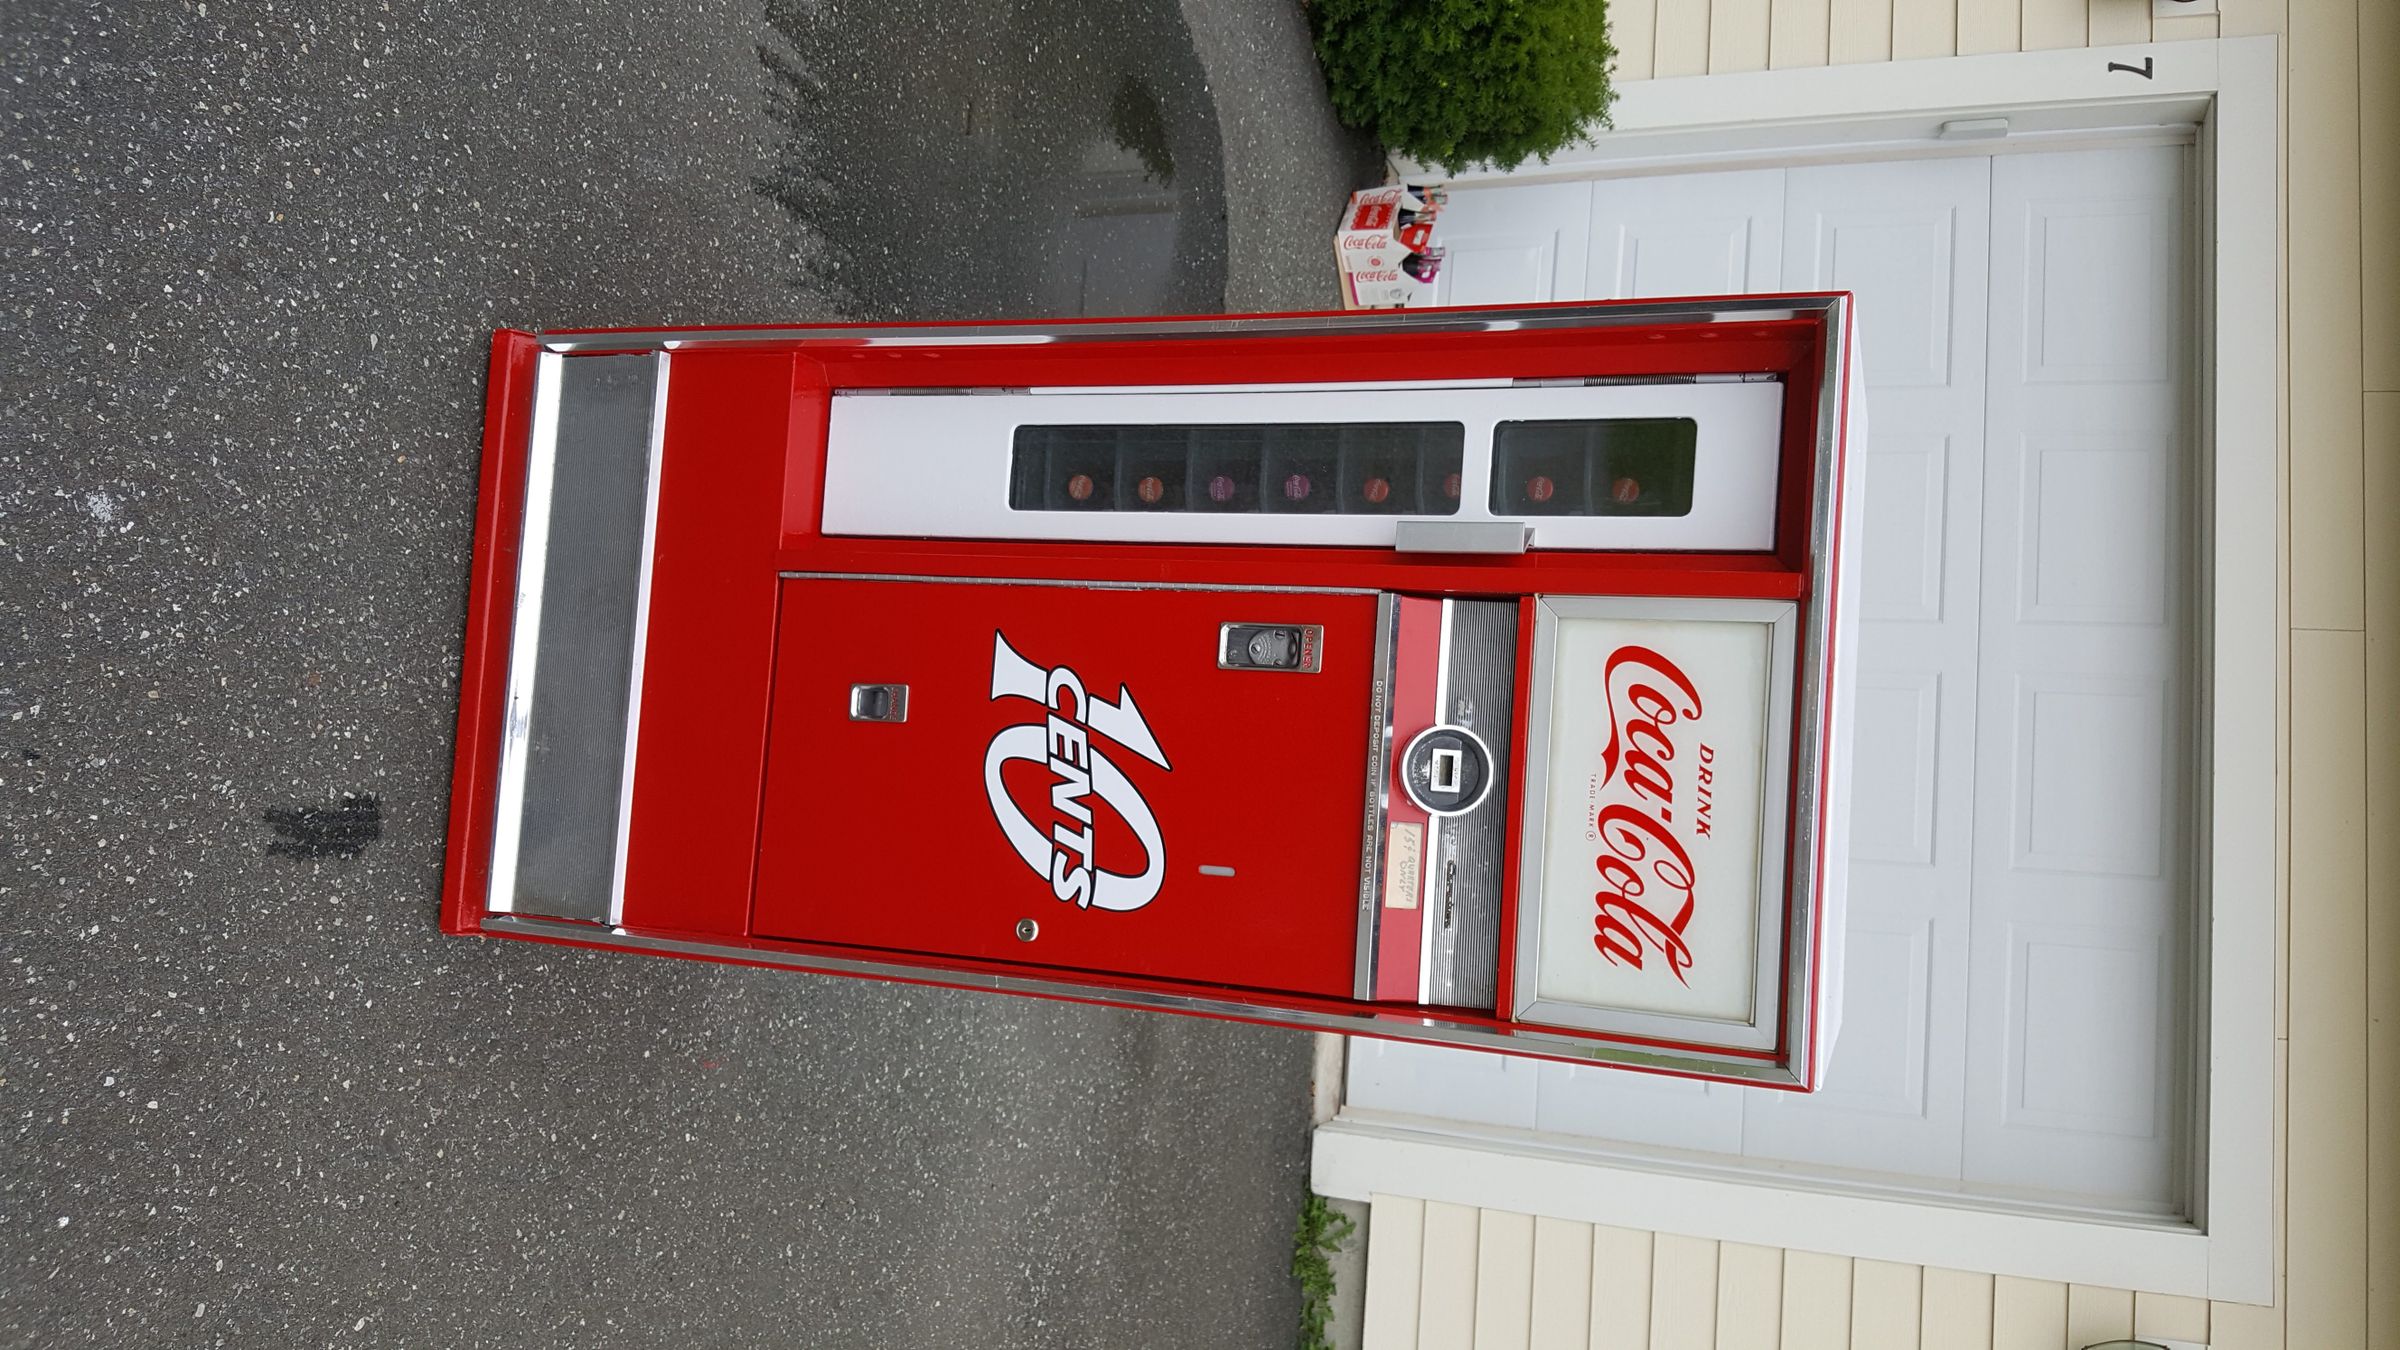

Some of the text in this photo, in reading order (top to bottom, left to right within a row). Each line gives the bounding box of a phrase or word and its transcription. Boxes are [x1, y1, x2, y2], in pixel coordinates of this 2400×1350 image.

[2108, 57, 2153, 80] 7
[1302, 629, 1314, 669] OPENER
[1374, 695, 1382, 712] NOT
[1375, 680, 1384, 693] DO
[1372, 715, 1381, 752] DEPOSIT
[983, 628, 1173, 912] 10
[1370, 756, 1378, 776] COIN
[1048, 666, 1093, 910] CENTS
[1696, 742, 1714, 840] DRINK
[1367, 791, 1376, 831] BOTTLES
[1594, 645, 1703, 990] Coca-Cola
[1364, 856, 1372, 874] NOT
[1399, 861, 1407, 892] ONLY
[1362, 877, 1371, 911] VISIBLE
